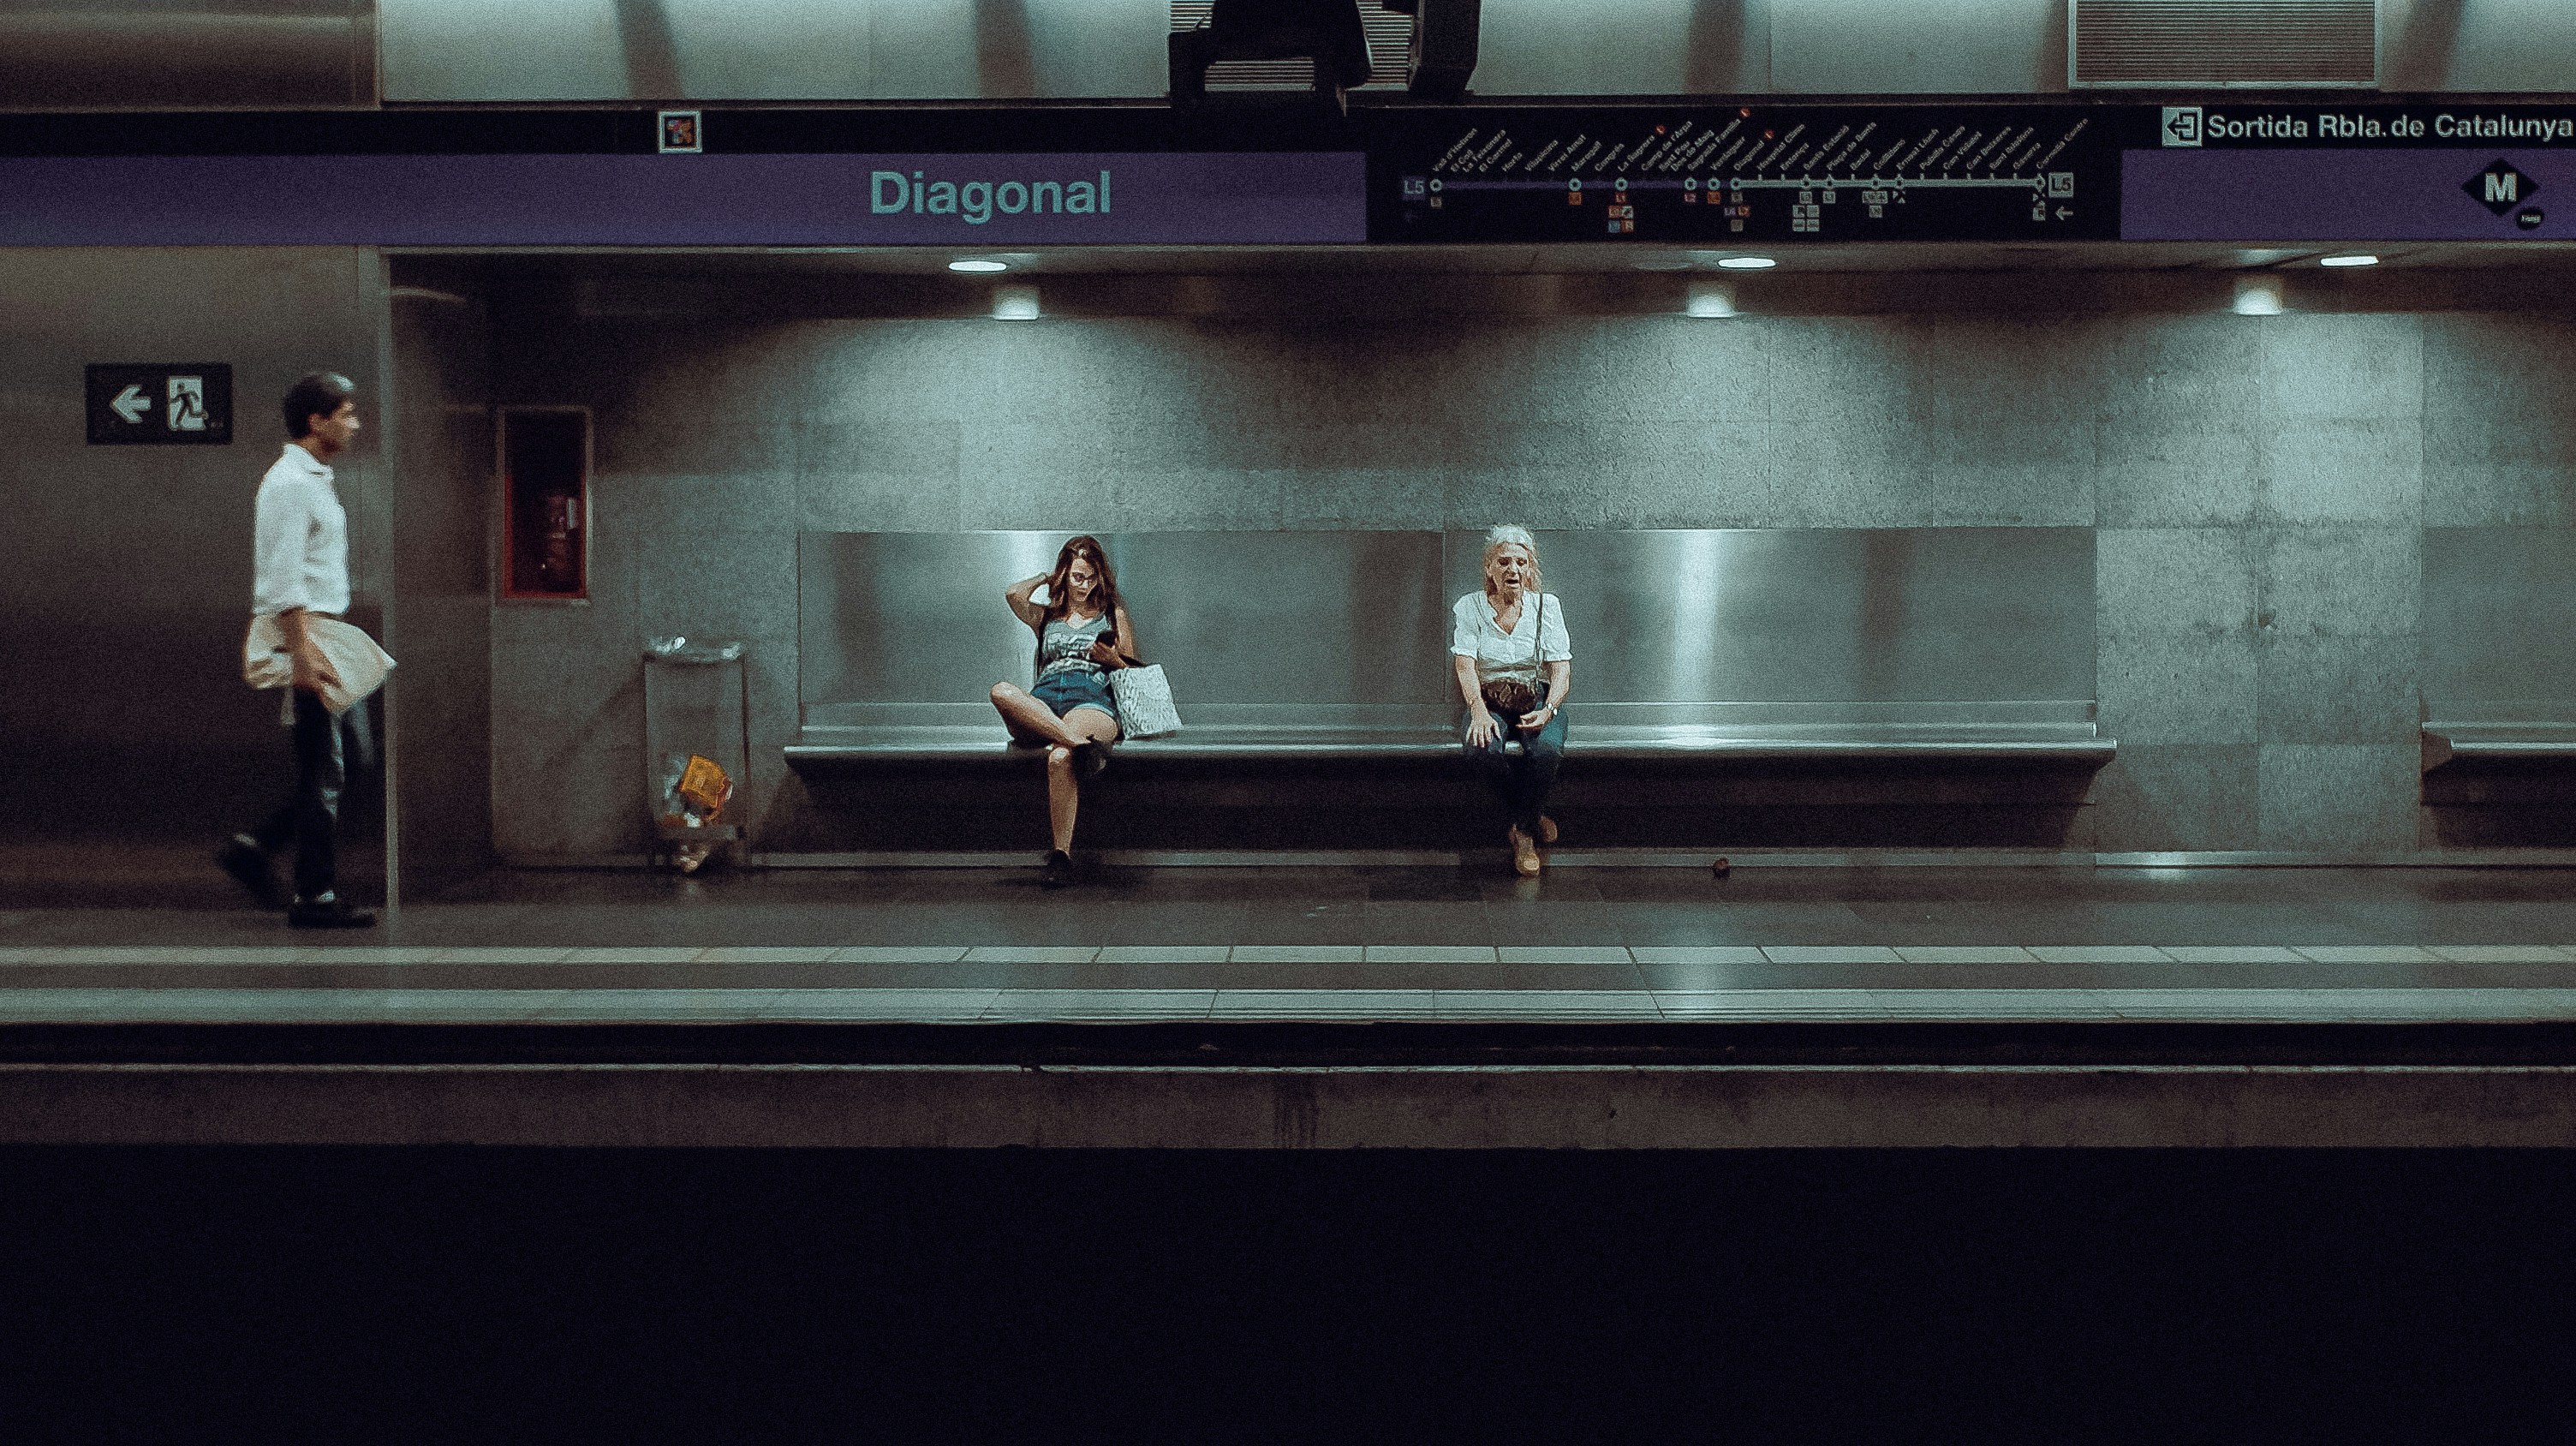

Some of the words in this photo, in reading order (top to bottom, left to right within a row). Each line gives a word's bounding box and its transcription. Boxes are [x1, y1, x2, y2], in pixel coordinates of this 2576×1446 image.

[2208, 114, 2308, 138] Sortida
[2435, 114, 2573, 142] Catalunya
[871, 170, 1111, 224] Diagonal
[1404, 180, 1425, 194] L5
[2051, 177, 2072, 192] L5
[2485, 174, 2516, 200] M
